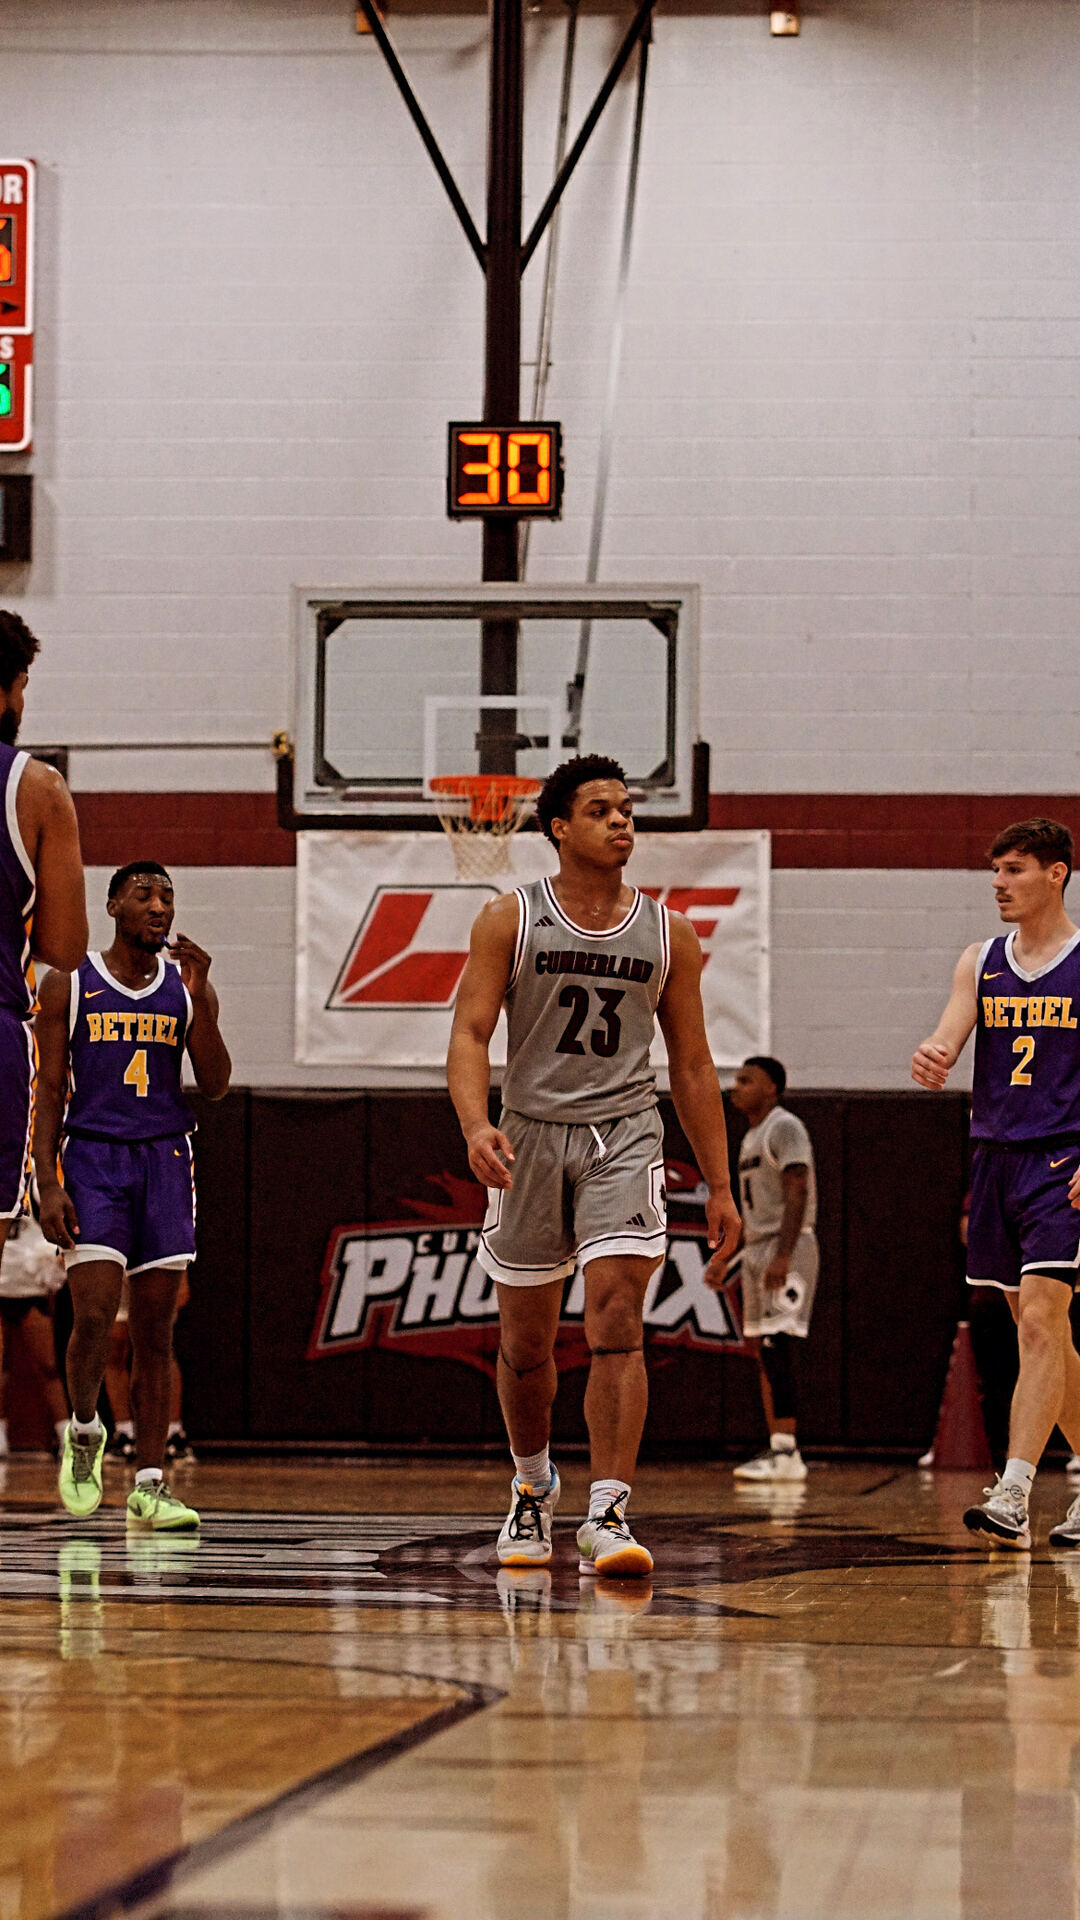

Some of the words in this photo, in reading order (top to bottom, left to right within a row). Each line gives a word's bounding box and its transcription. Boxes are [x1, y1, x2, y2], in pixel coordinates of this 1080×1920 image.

[457, 432, 550, 504] 30
[535, 950, 654, 984] CUMBERLAND
[86, 1012, 178, 1046] BETHEL
[555, 985, 626, 1058] 23
[982, 996, 1078, 1029] BETHEL
[124, 1049, 150, 1097] 4
[1010, 1035, 1035, 1086] 2
[329, 1237, 731, 1336] PHOX
